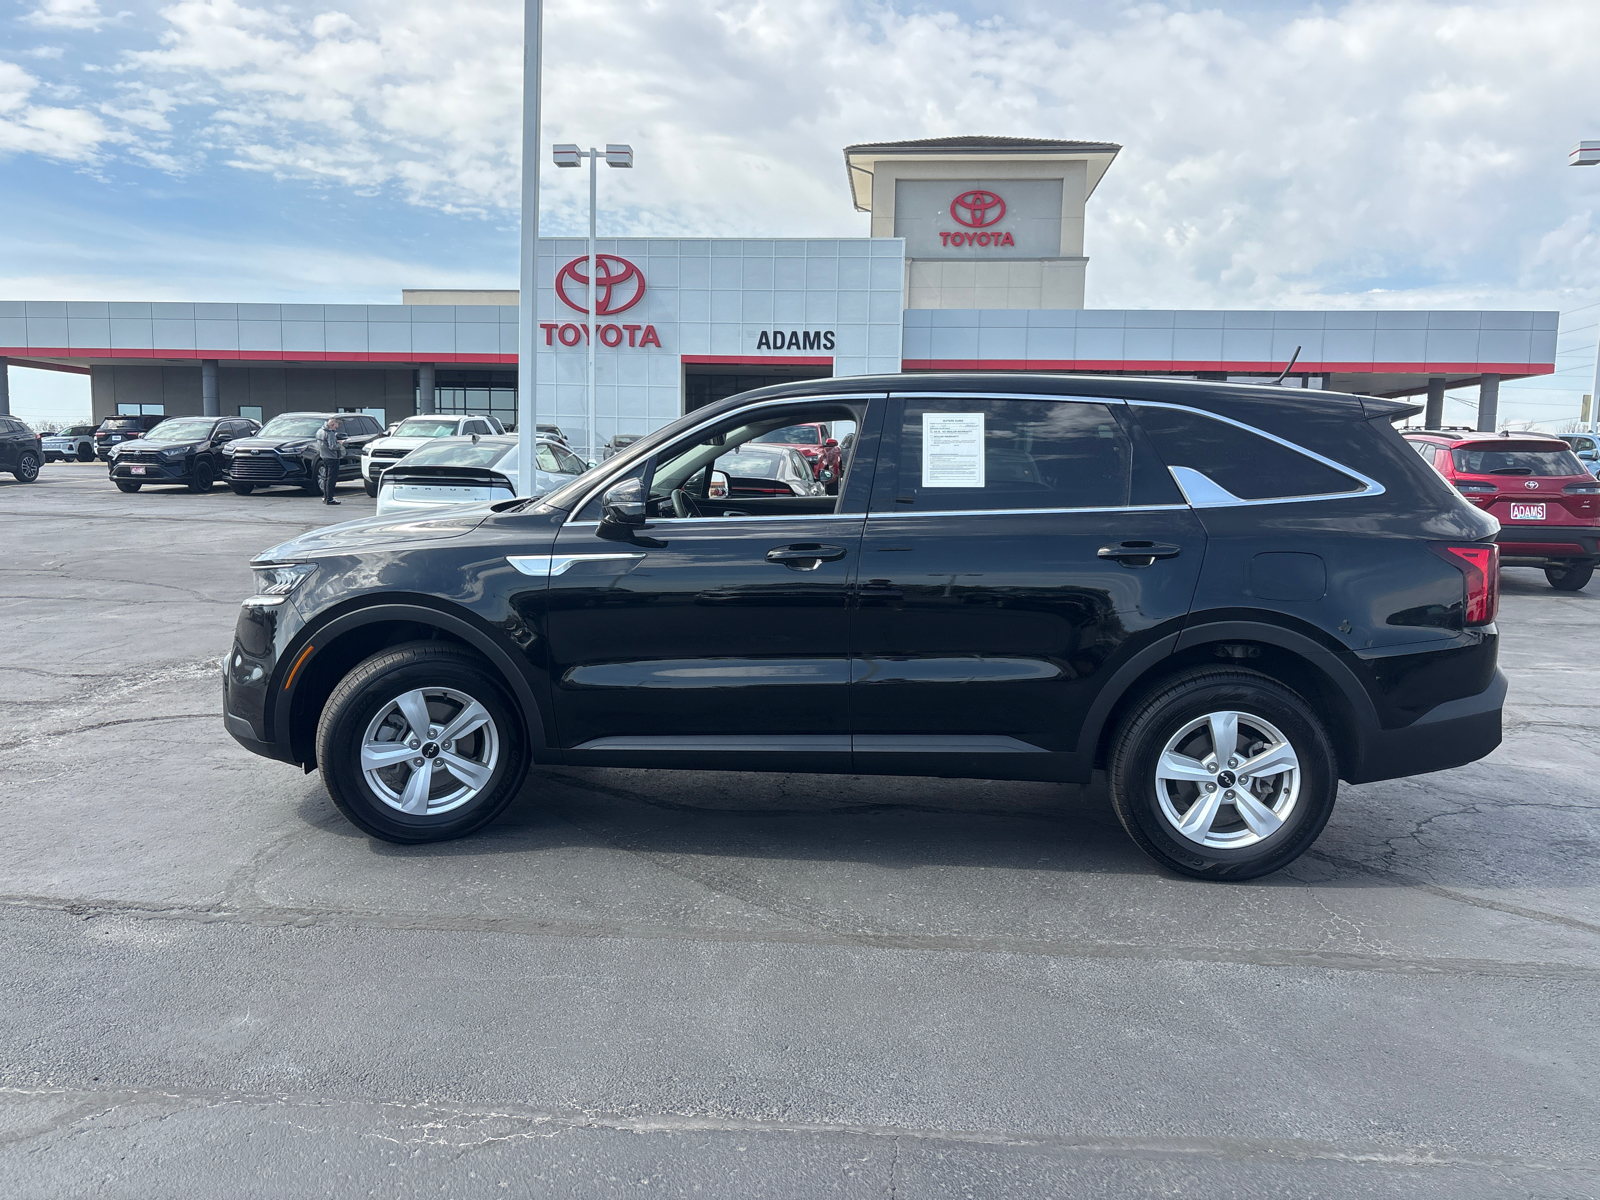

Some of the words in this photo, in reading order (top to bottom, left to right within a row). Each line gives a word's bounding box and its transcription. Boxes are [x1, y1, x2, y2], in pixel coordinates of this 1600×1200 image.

[939, 231, 1015, 247] TOYOTA
[756, 330, 836, 350] ADAMS
[1513, 506, 1543, 517] ADAMS
